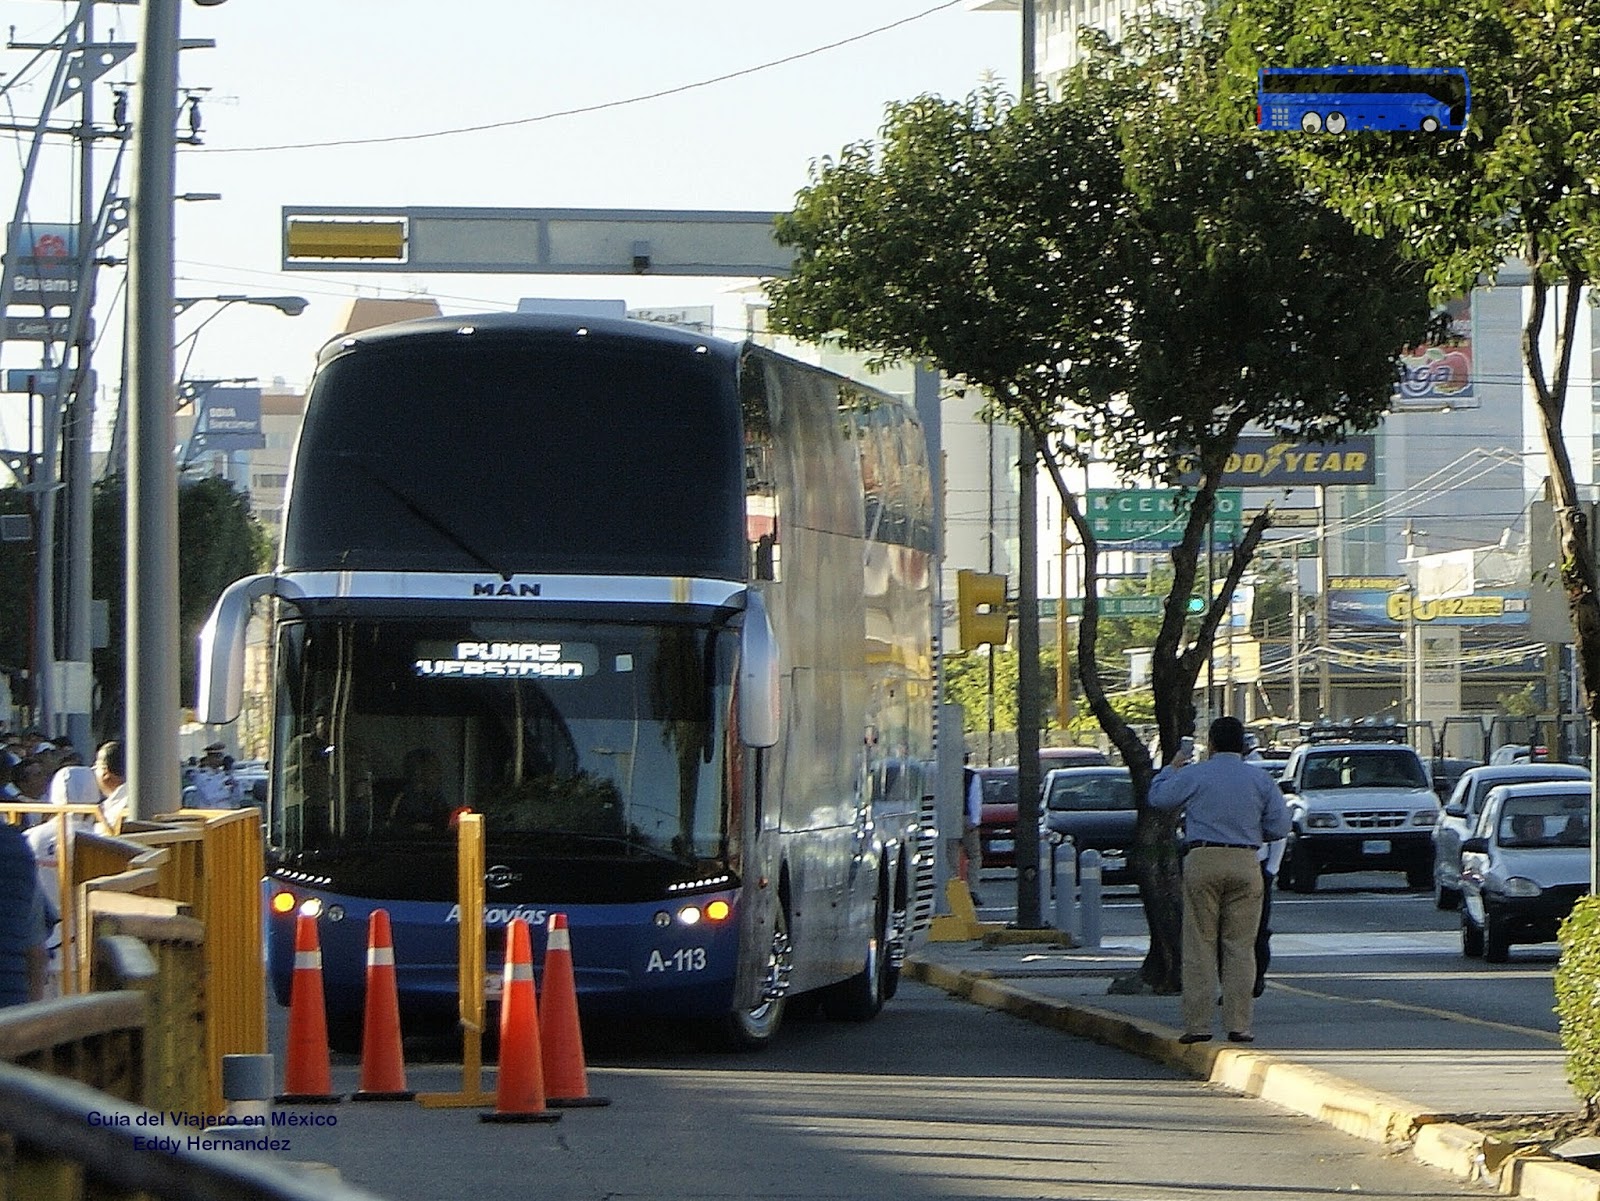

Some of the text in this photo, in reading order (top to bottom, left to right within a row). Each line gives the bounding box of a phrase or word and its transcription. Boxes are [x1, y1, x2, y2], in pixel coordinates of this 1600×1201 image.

[1117, 497, 1234, 513] CENO
[473, 583, 541, 597] MAN
[457, 641, 562, 662] PUMAS
[646, 947, 707, 973] A-113
